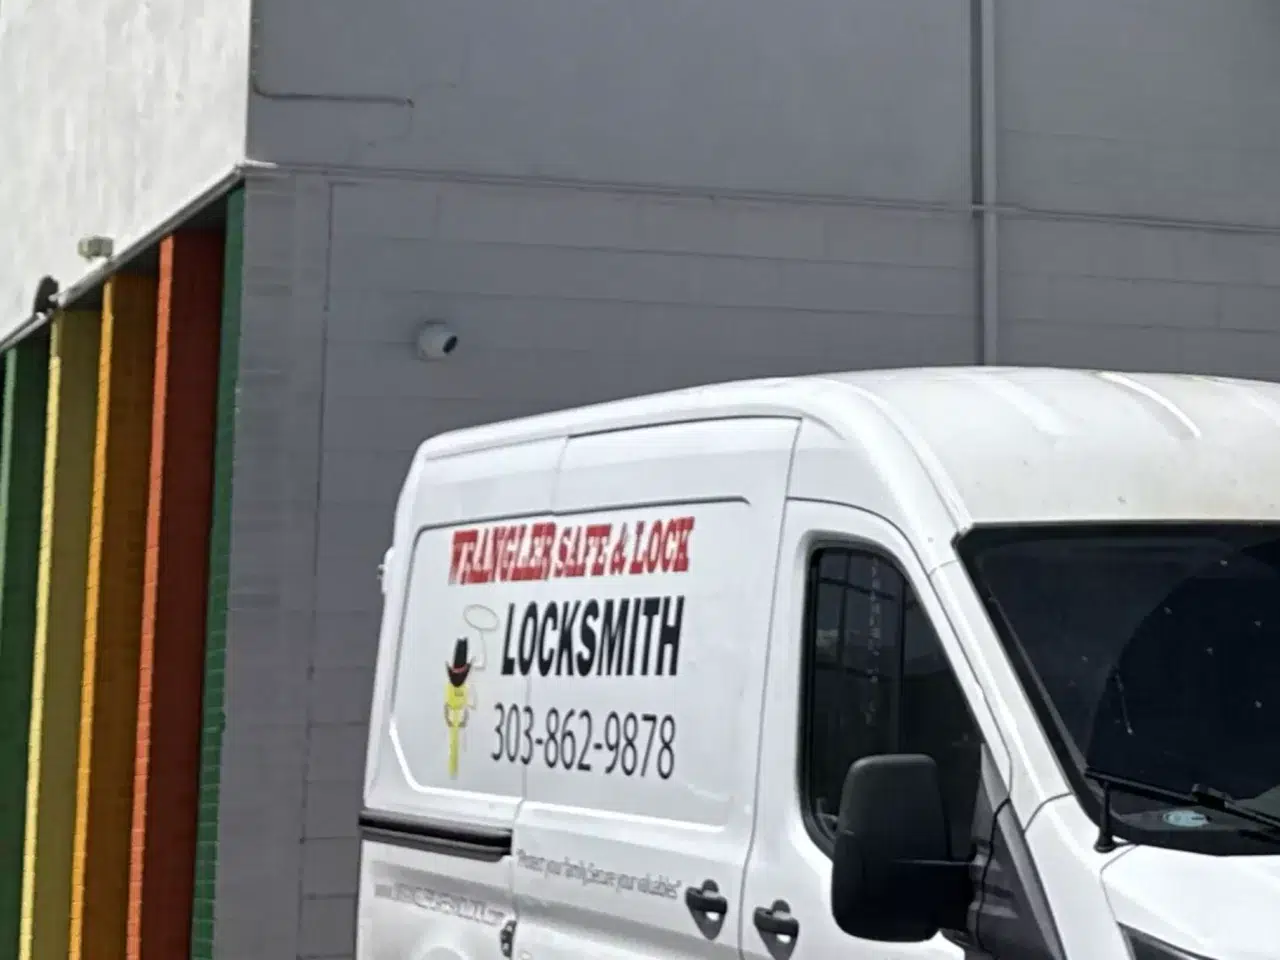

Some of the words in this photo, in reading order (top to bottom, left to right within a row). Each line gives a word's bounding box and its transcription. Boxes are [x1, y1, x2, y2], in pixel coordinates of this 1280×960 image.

[554, 524, 612, 577] SAFE
[628, 516, 696, 575] LOCK
[500, 595, 685, 678] LOCKSMITH
[490, 701, 676, 780] 303-862-9878
